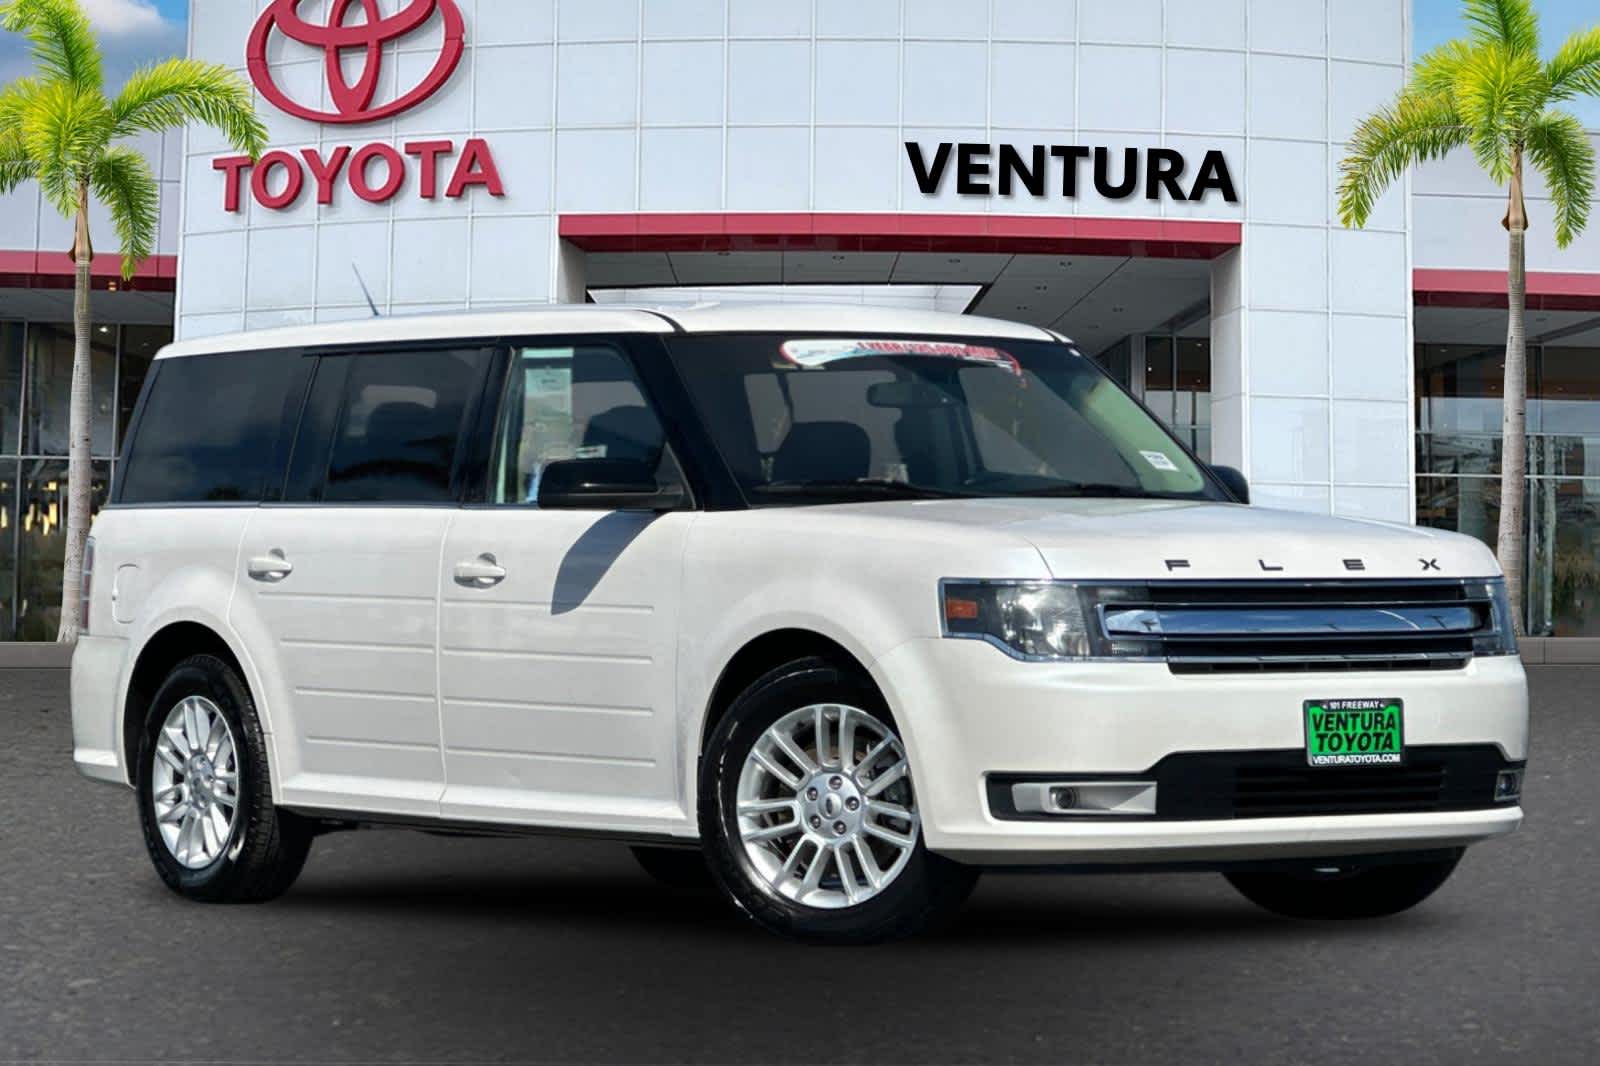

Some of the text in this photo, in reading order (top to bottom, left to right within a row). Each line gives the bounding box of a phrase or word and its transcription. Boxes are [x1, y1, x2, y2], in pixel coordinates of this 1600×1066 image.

[212, 138, 505, 212] TOYOTA
[904, 141, 1238, 202] VENTURA
[1341, 701, 1380, 710] FREEWAY
[1312, 712, 1397, 731] VENTURA
[1315, 732, 1395, 752] TOYOTA
[1313, 753, 1401, 764] VENTURATOYOTA.COM
